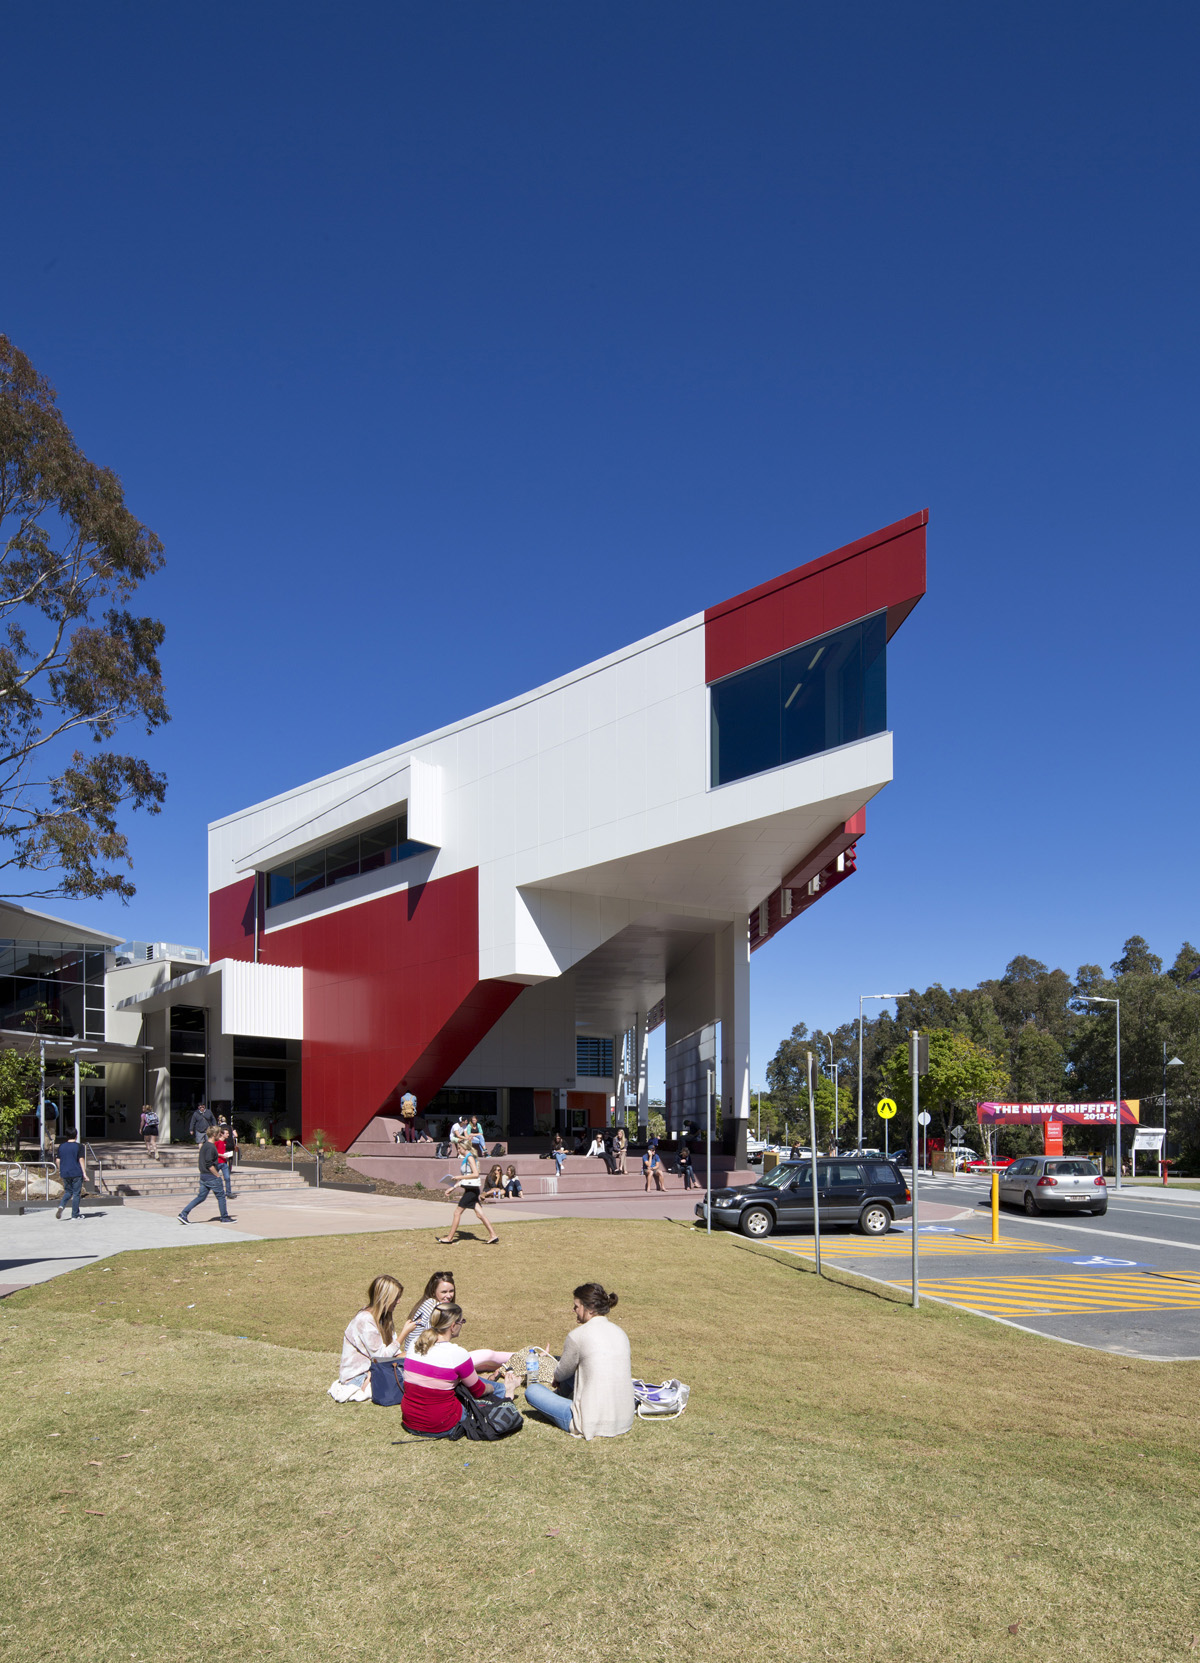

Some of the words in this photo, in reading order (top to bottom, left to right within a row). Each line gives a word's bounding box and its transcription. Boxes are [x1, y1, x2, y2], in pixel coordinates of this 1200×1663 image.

[993, 1105, 1019, 1114] THE
[1023, 1105, 1054, 1114] NEW
[1056, 1104, 1117, 1113] GRIFFITH
